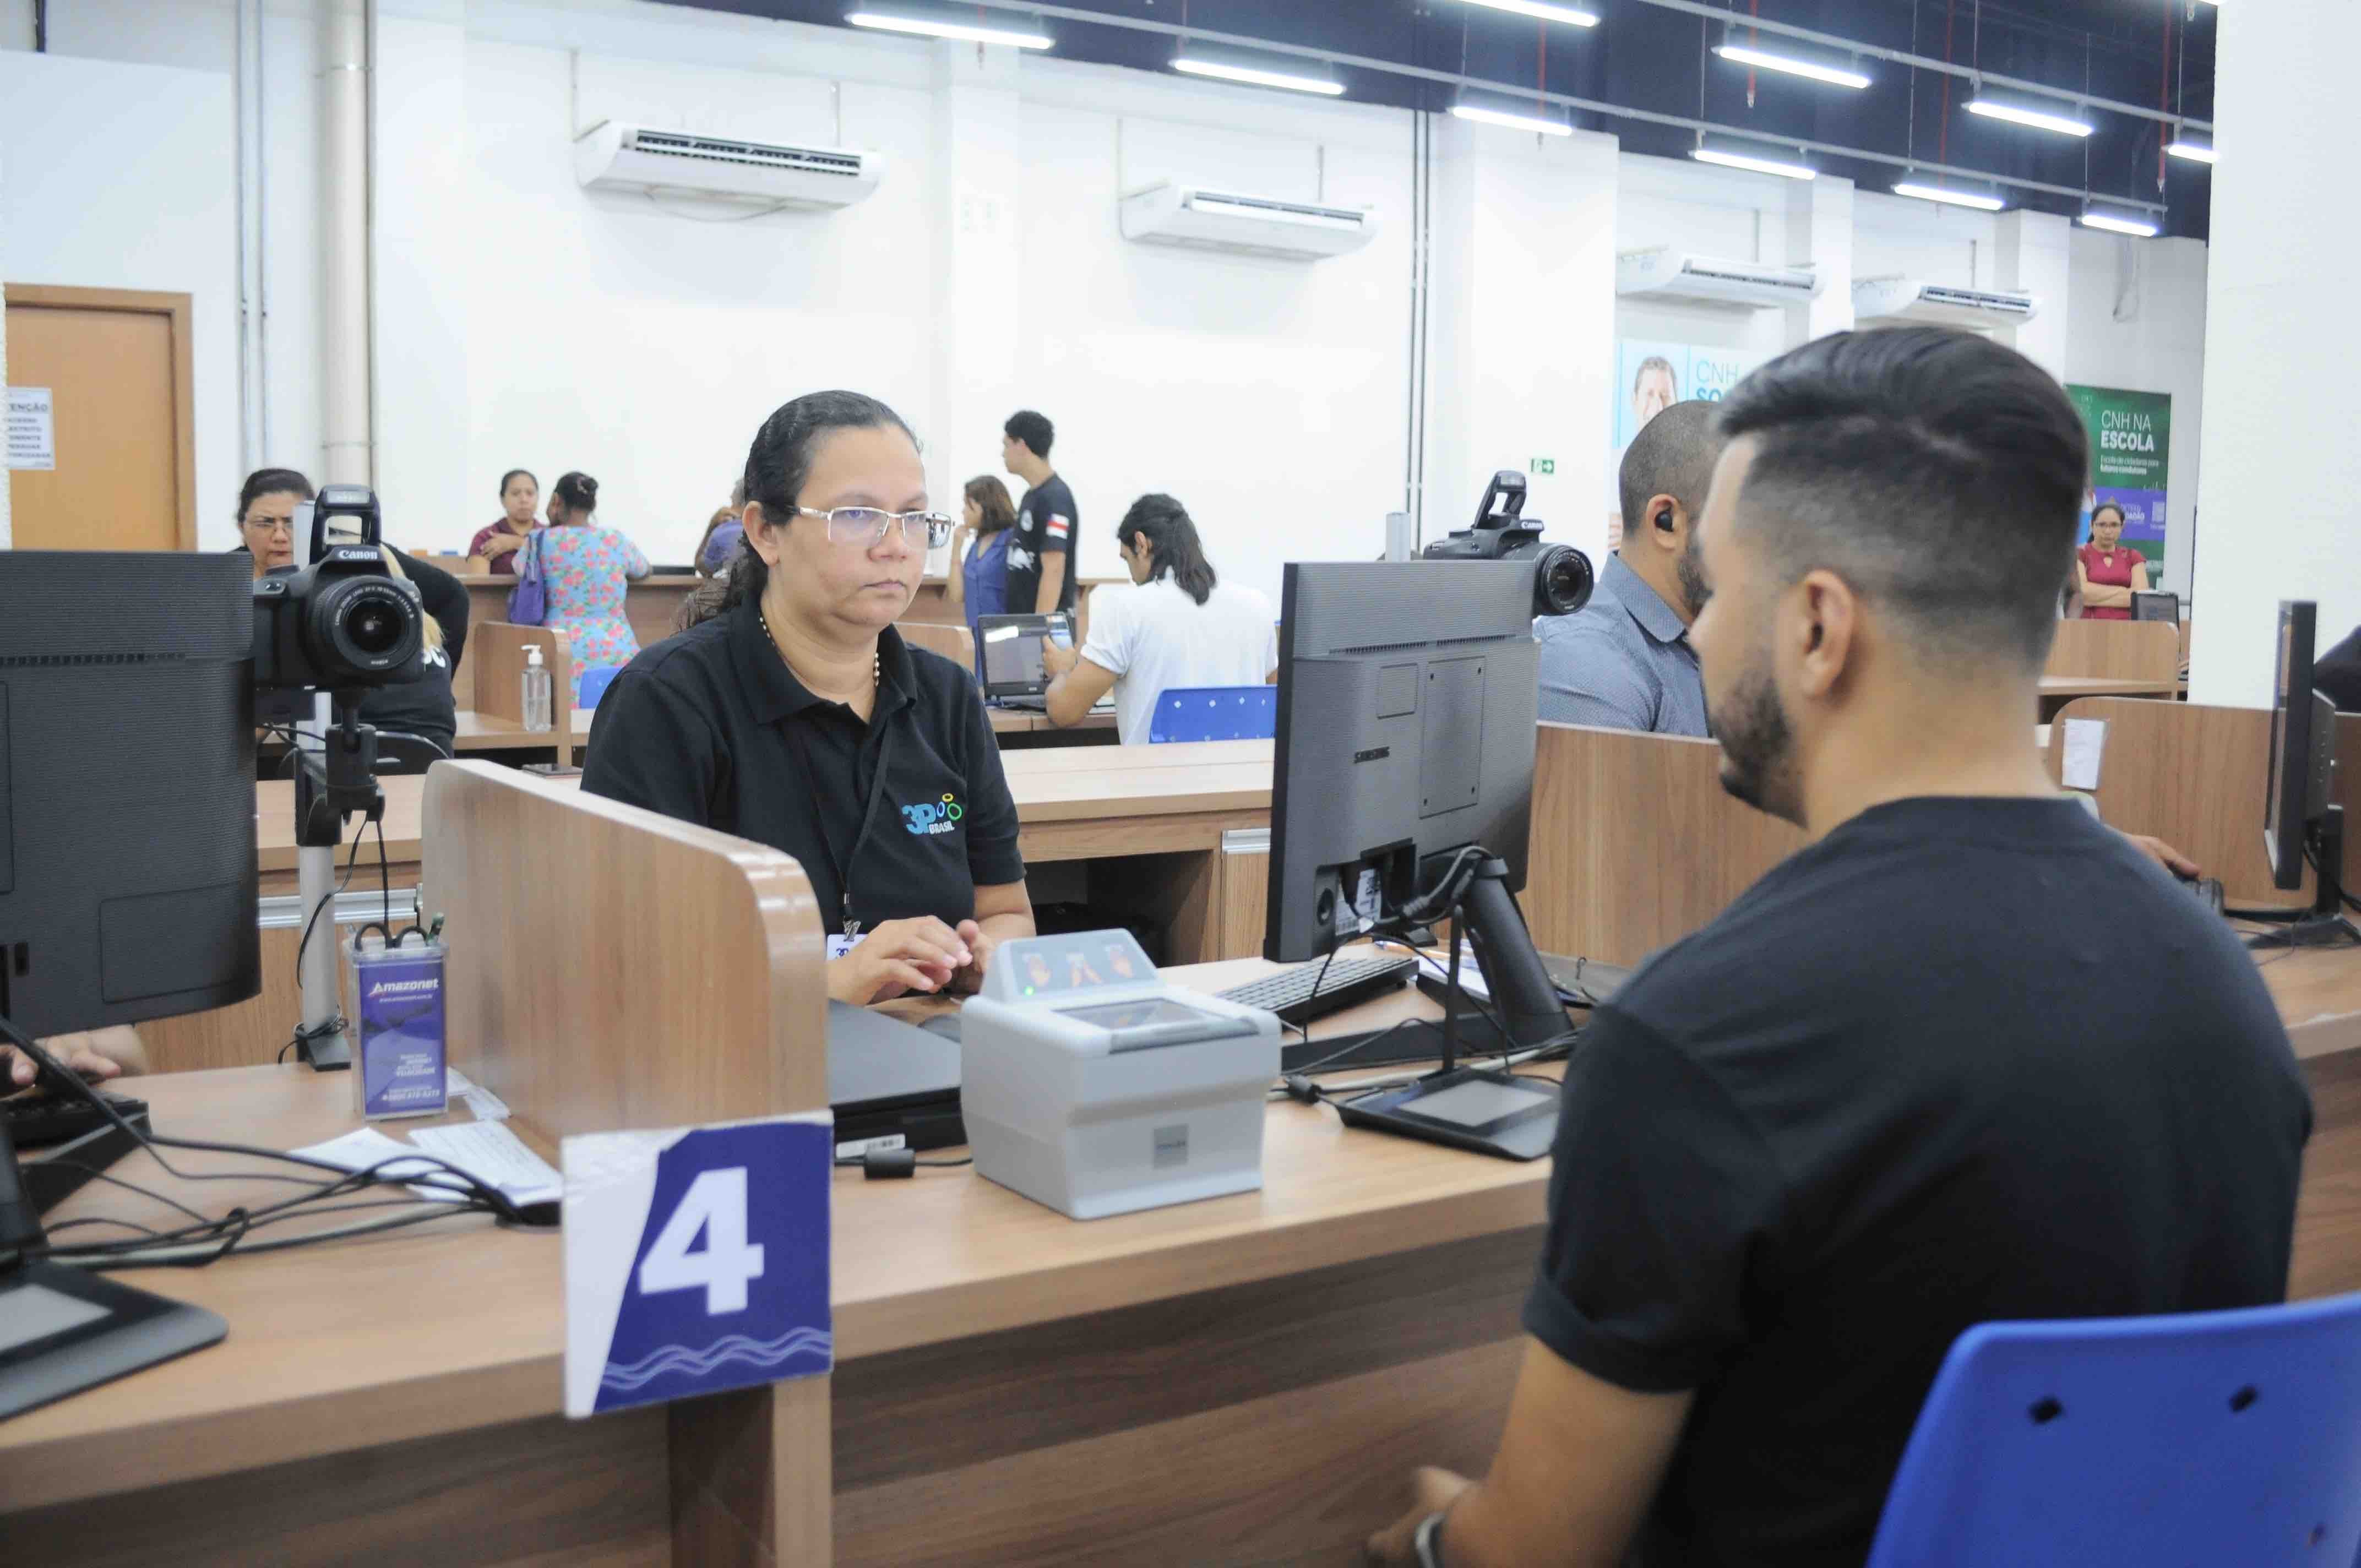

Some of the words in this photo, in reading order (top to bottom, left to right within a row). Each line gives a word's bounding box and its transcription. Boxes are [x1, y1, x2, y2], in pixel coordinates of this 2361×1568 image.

[1696, 360, 1738, 384] CNH
[2101, 410, 2130, 430] CNH
[2133, 413, 2151, 432] NA
[2101, 429, 2155, 452] ESCOLA
[338, 550, 378, 560] Canon
[928, 820, 955, 835] BRASIL
[373, 977, 439, 993] Amazonet
[639, 1166, 764, 1316] 4
